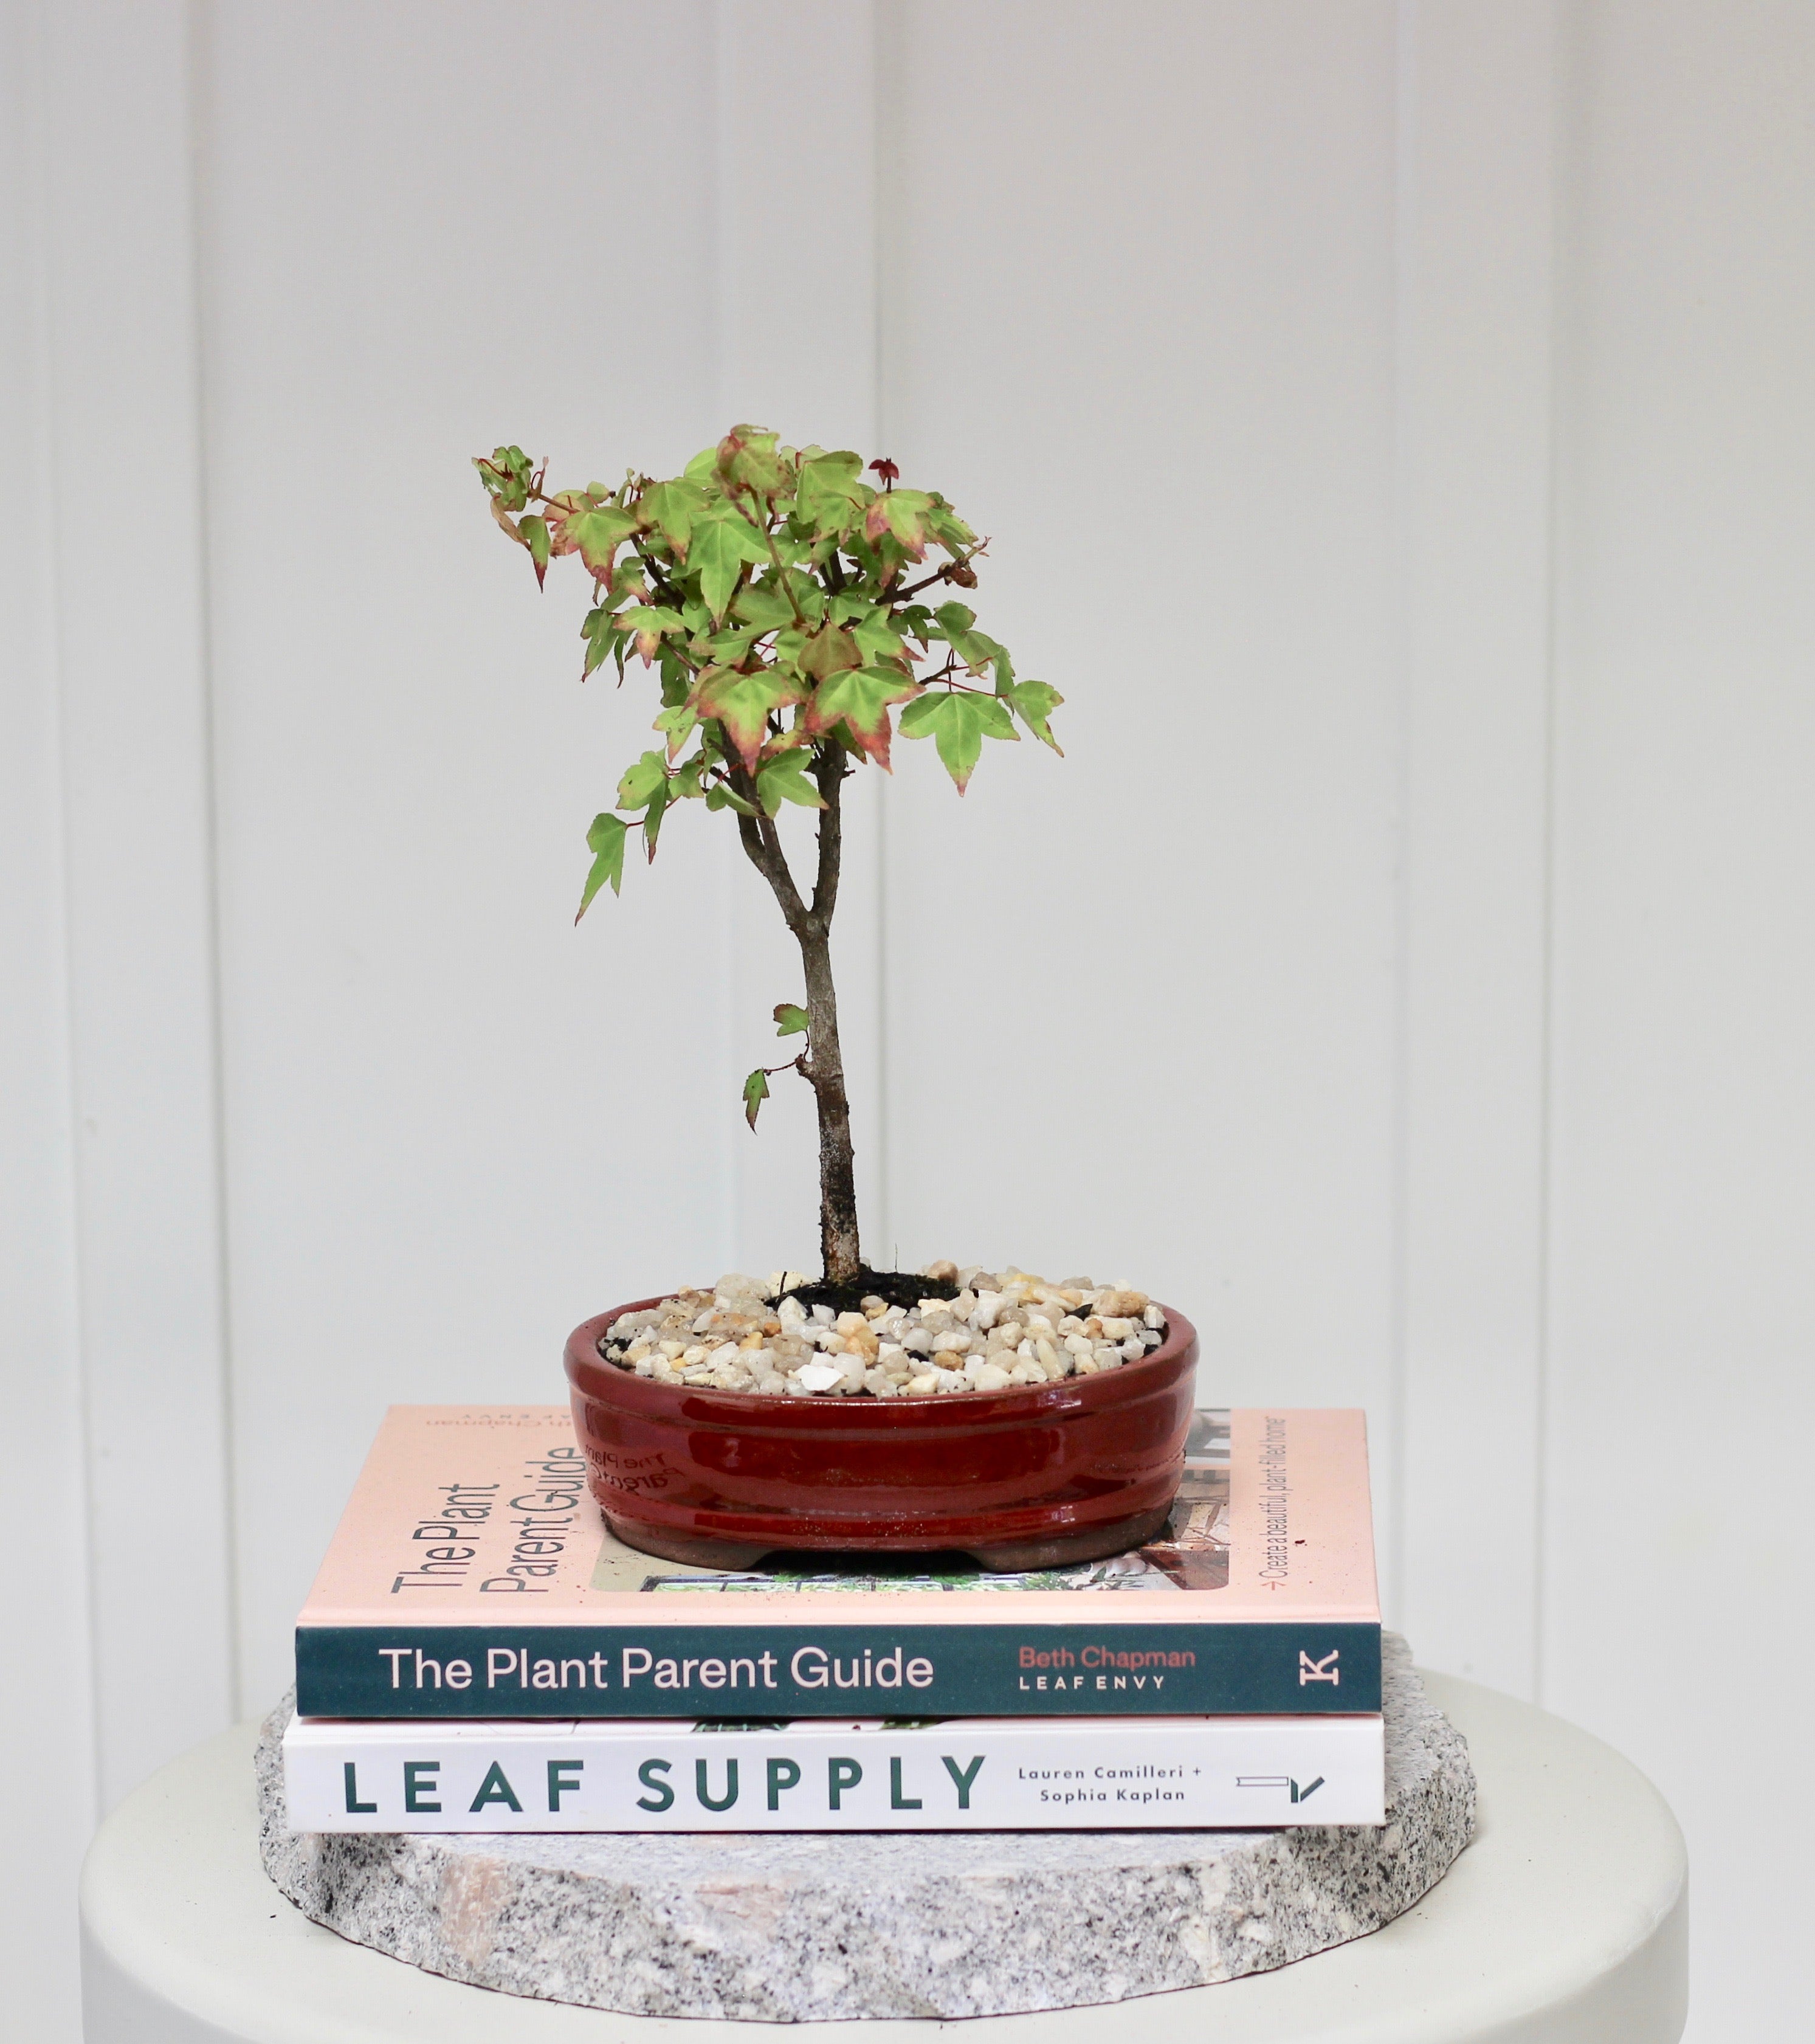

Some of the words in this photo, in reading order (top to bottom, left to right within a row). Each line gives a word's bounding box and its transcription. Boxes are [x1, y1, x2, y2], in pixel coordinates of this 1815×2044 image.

[1259, 1418, 1287, 1443] home
[509, 1447, 586, 1512] Guide
[1259, 1444, 1293, 1491] plant-filled
[412, 1483, 500, 1539] Plant
[1259, 1494, 1290, 1536] beautiful,
[391, 1547, 475, 1593] The
[480, 1517, 573, 1592] Parent
[1259, 1545, 1288, 1578] Create
[378, 1648, 472, 1688] The
[487, 1648, 608, 1689] Plant
[622, 1647, 778, 1688] Parent
[790, 1646, 934, 1688] Guide
[1019, 1647, 1074, 1668] Beth
[1081, 1645, 1196, 1672] Chapman
[1299, 1649, 1340, 1687] K
[1019, 1676, 1084, 1690] LEAF
[1096, 1676, 1165, 1690] ENVY
[343, 1760, 584, 1814] LEAF
[636, 1756, 986, 1812] SUPPLY
[1018, 1767, 1085, 1780] Lauren
[1094, 1766, 1182, 1779] Camilleri
[1040, 1789, 1107, 1804] Sophia
[1117, 1788, 1185, 1804] Kaplan
